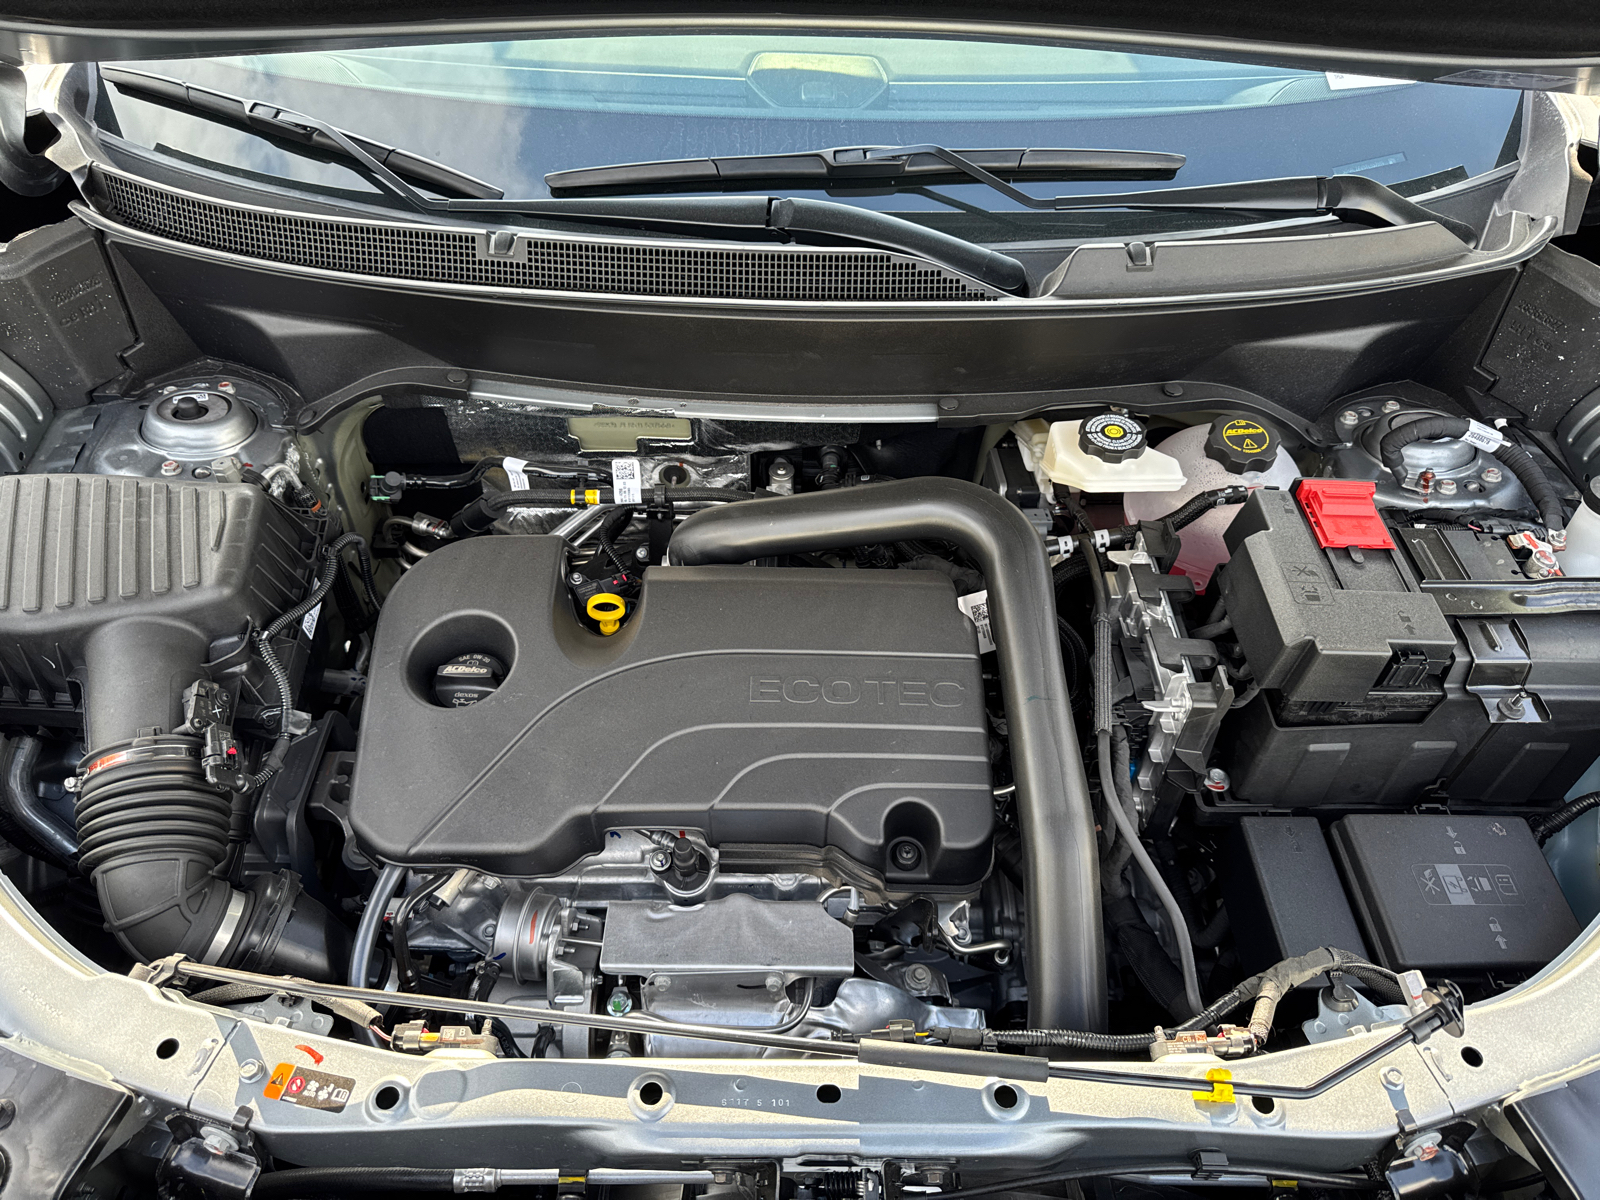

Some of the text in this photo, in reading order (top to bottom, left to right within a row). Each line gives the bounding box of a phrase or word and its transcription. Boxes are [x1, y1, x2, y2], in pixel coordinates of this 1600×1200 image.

[458, 653, 491, 663] SAE 0W-20
[442, 665, 488, 674] ACDelco
[749, 675, 966, 708] ECOTEC
[771, 1098, 790, 1107] 101
